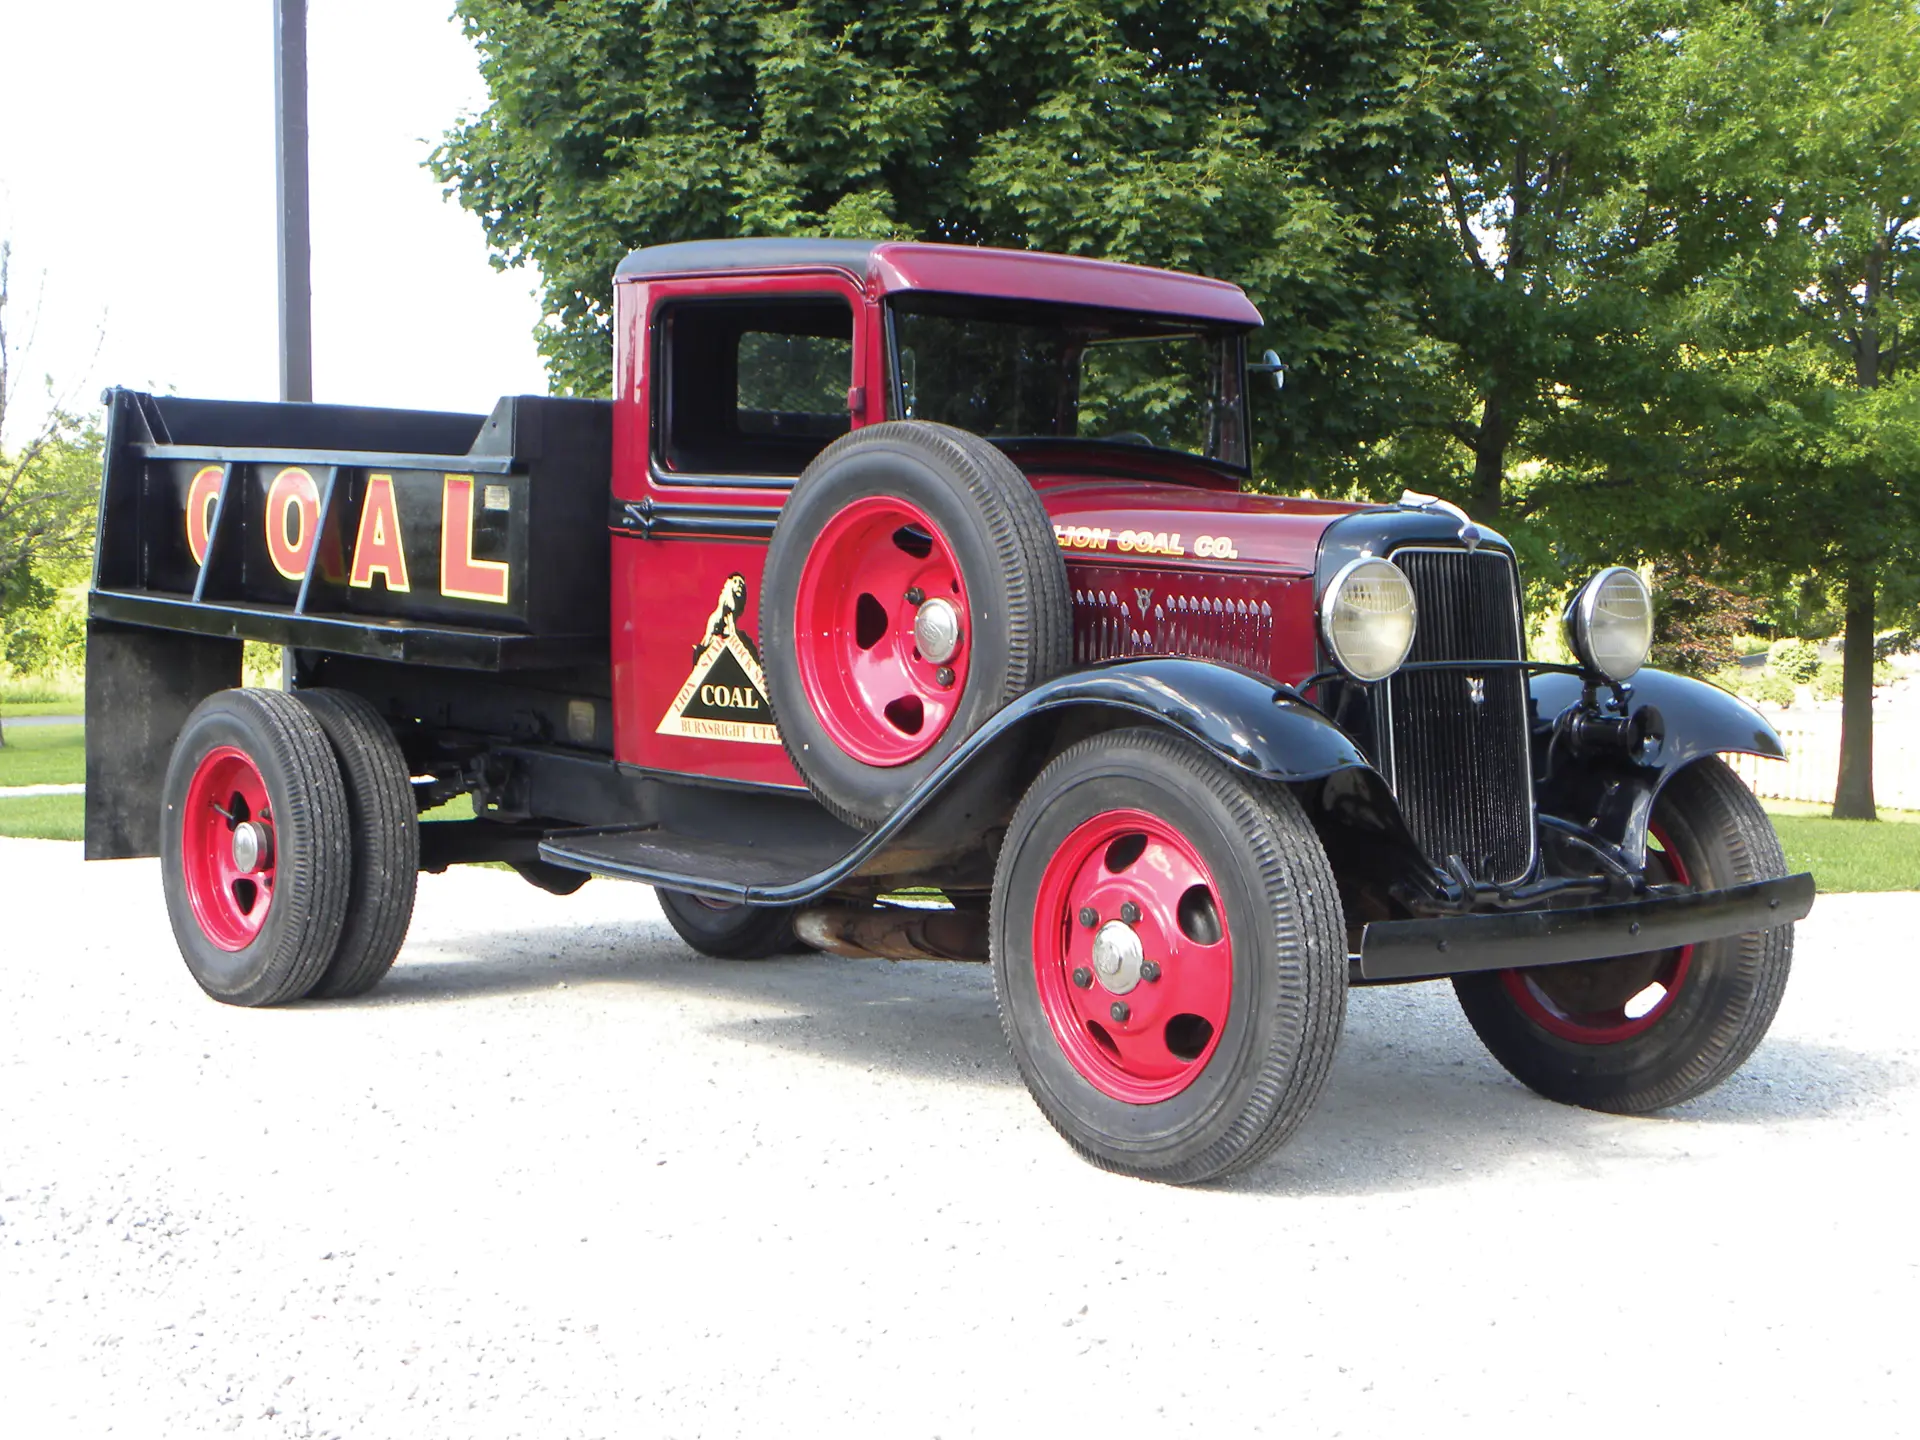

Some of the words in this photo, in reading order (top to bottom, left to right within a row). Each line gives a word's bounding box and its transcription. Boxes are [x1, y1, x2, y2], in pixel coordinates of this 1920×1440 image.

[186, 465, 510, 604] COAL
[1053, 525, 1110, 549] LION
[1117, 530, 1184, 555] COAL
[1194, 536, 1238, 559] CO.
[701, 684, 759, 709] COAL
[681, 720, 746, 739] BURNSRIGHT
